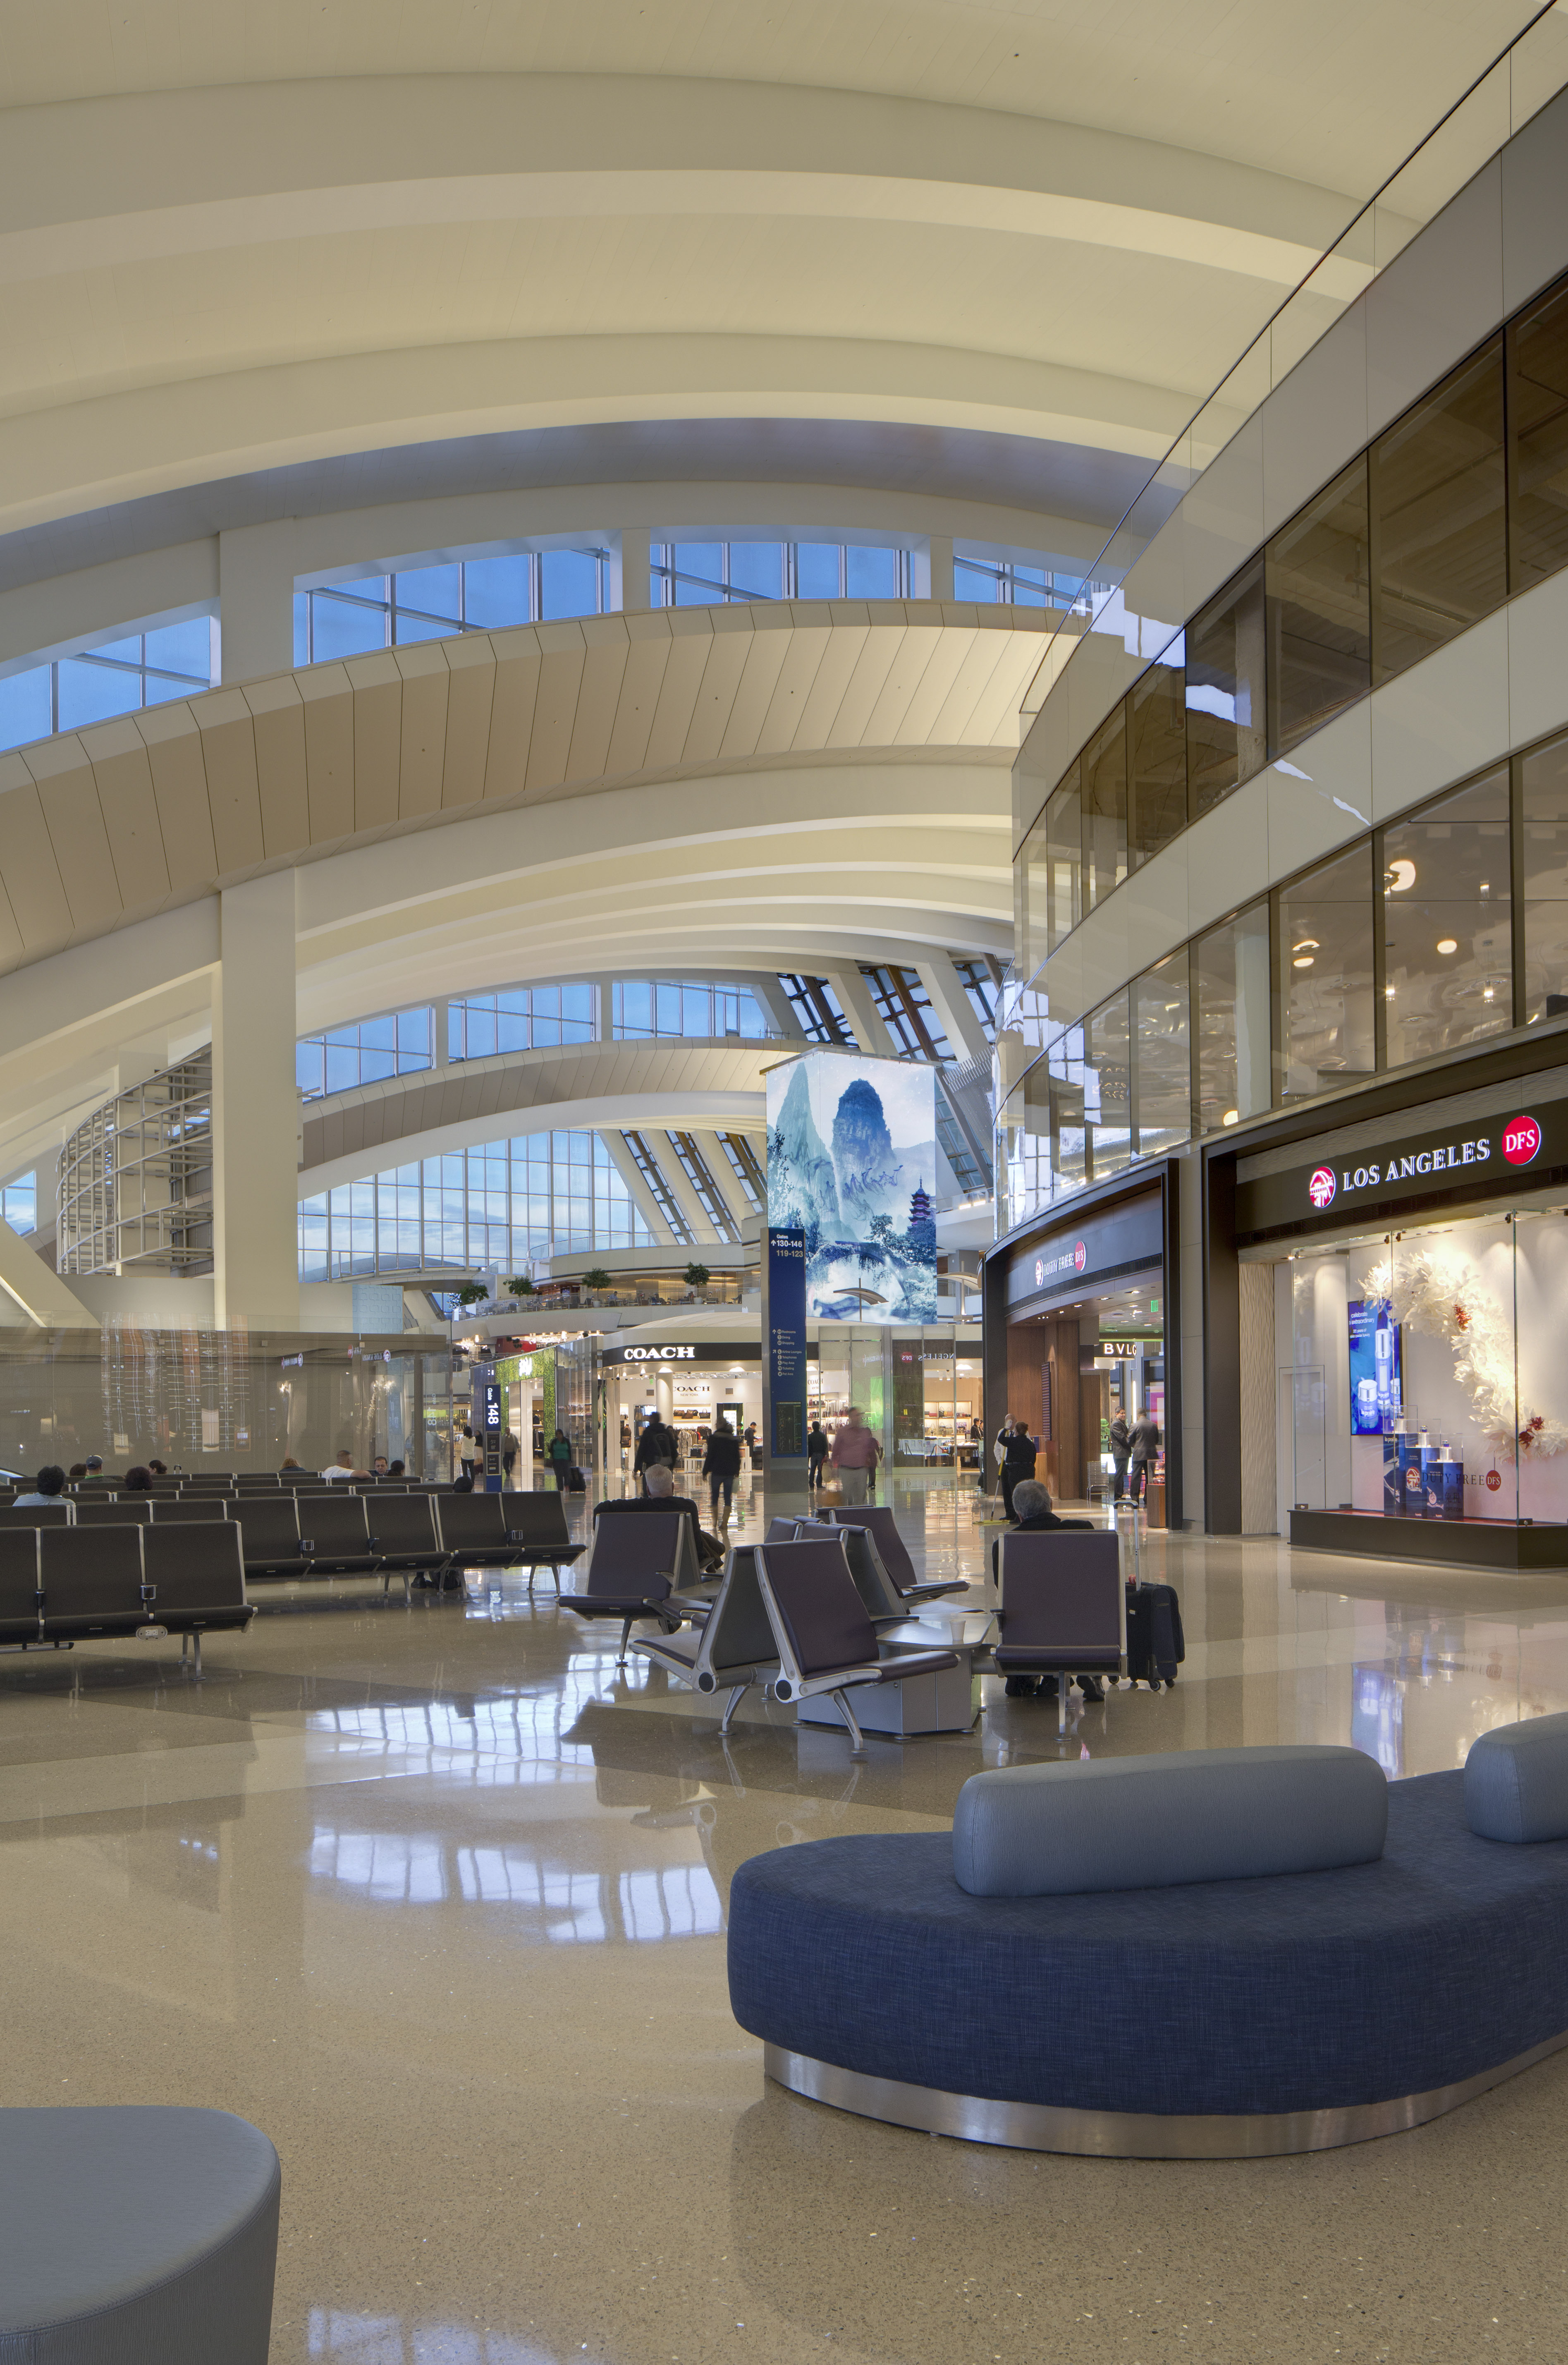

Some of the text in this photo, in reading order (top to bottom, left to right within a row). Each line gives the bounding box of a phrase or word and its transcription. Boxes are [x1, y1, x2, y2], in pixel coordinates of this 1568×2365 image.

[1343, 1130, 1535, 1191] LOS ANGELES DFS
[1044, 1250, 1083, 1276] DUTY FREE DFS
[624, 1347, 695, 1360] COACH
[488, 1403, 499, 1424] 148
[1422, 1472, 1451, 1483] DUTY
[1456, 1474, 1484, 1485] FREE
[1487, 1477, 1500, 1485] DFS
